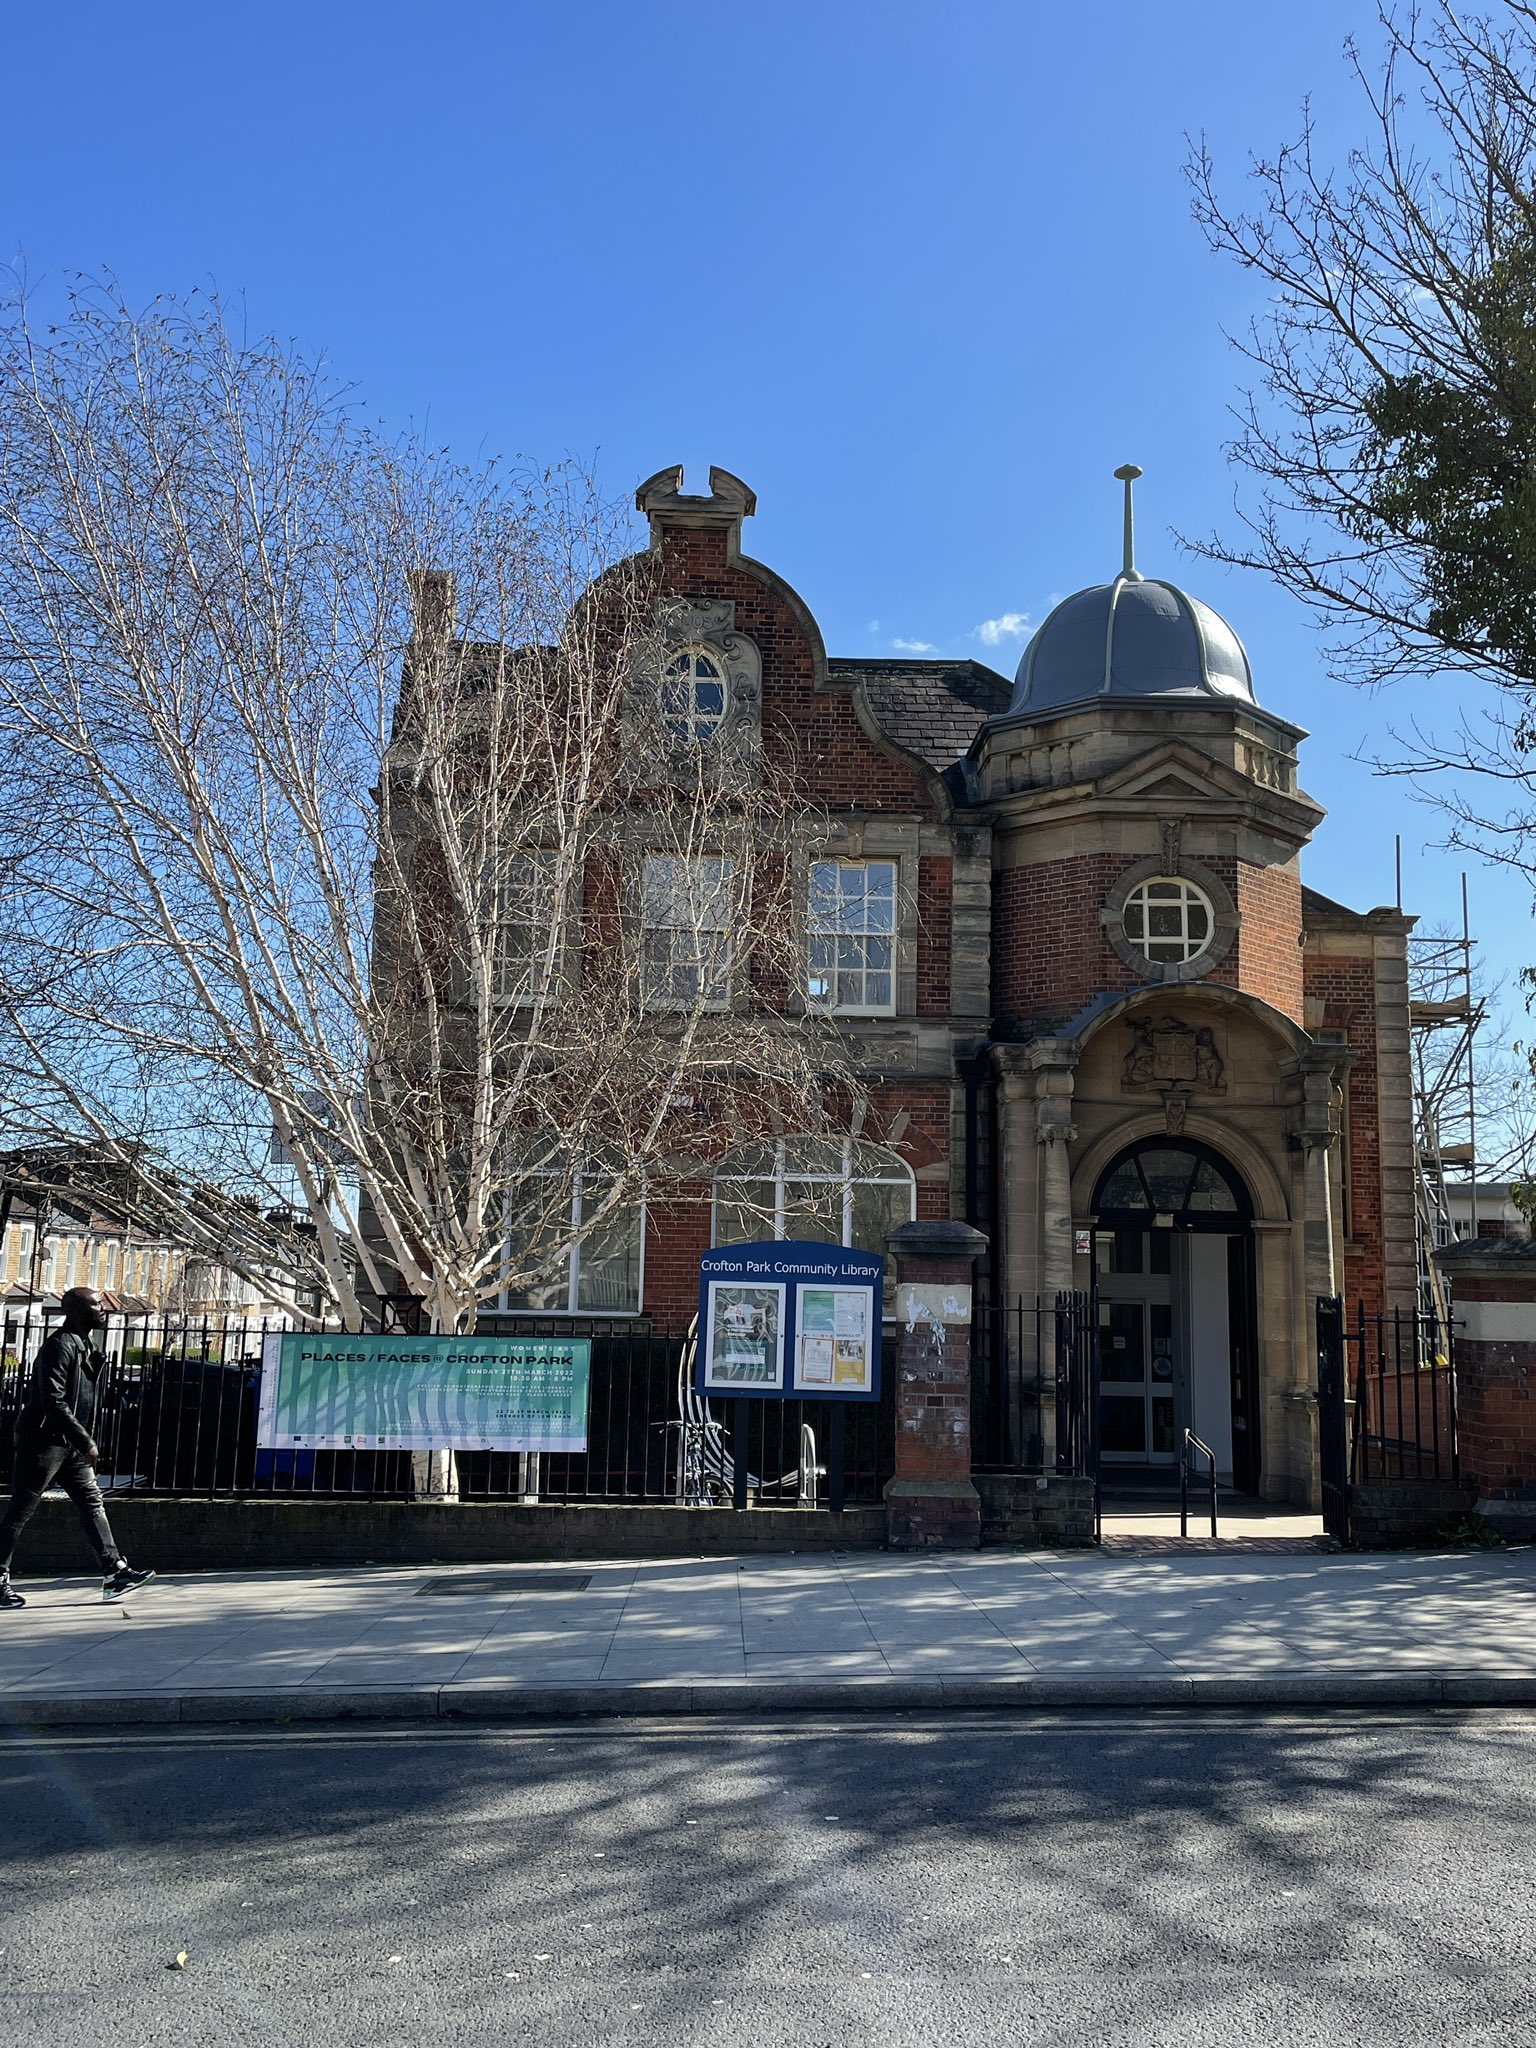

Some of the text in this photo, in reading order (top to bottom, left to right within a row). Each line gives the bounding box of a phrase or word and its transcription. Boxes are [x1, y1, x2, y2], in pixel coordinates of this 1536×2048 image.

[701, 1260, 880, 1279] Crofton Park Community Library
[301, 1352, 573, 1365] PLACES / FACES @ CROFTON PARK
